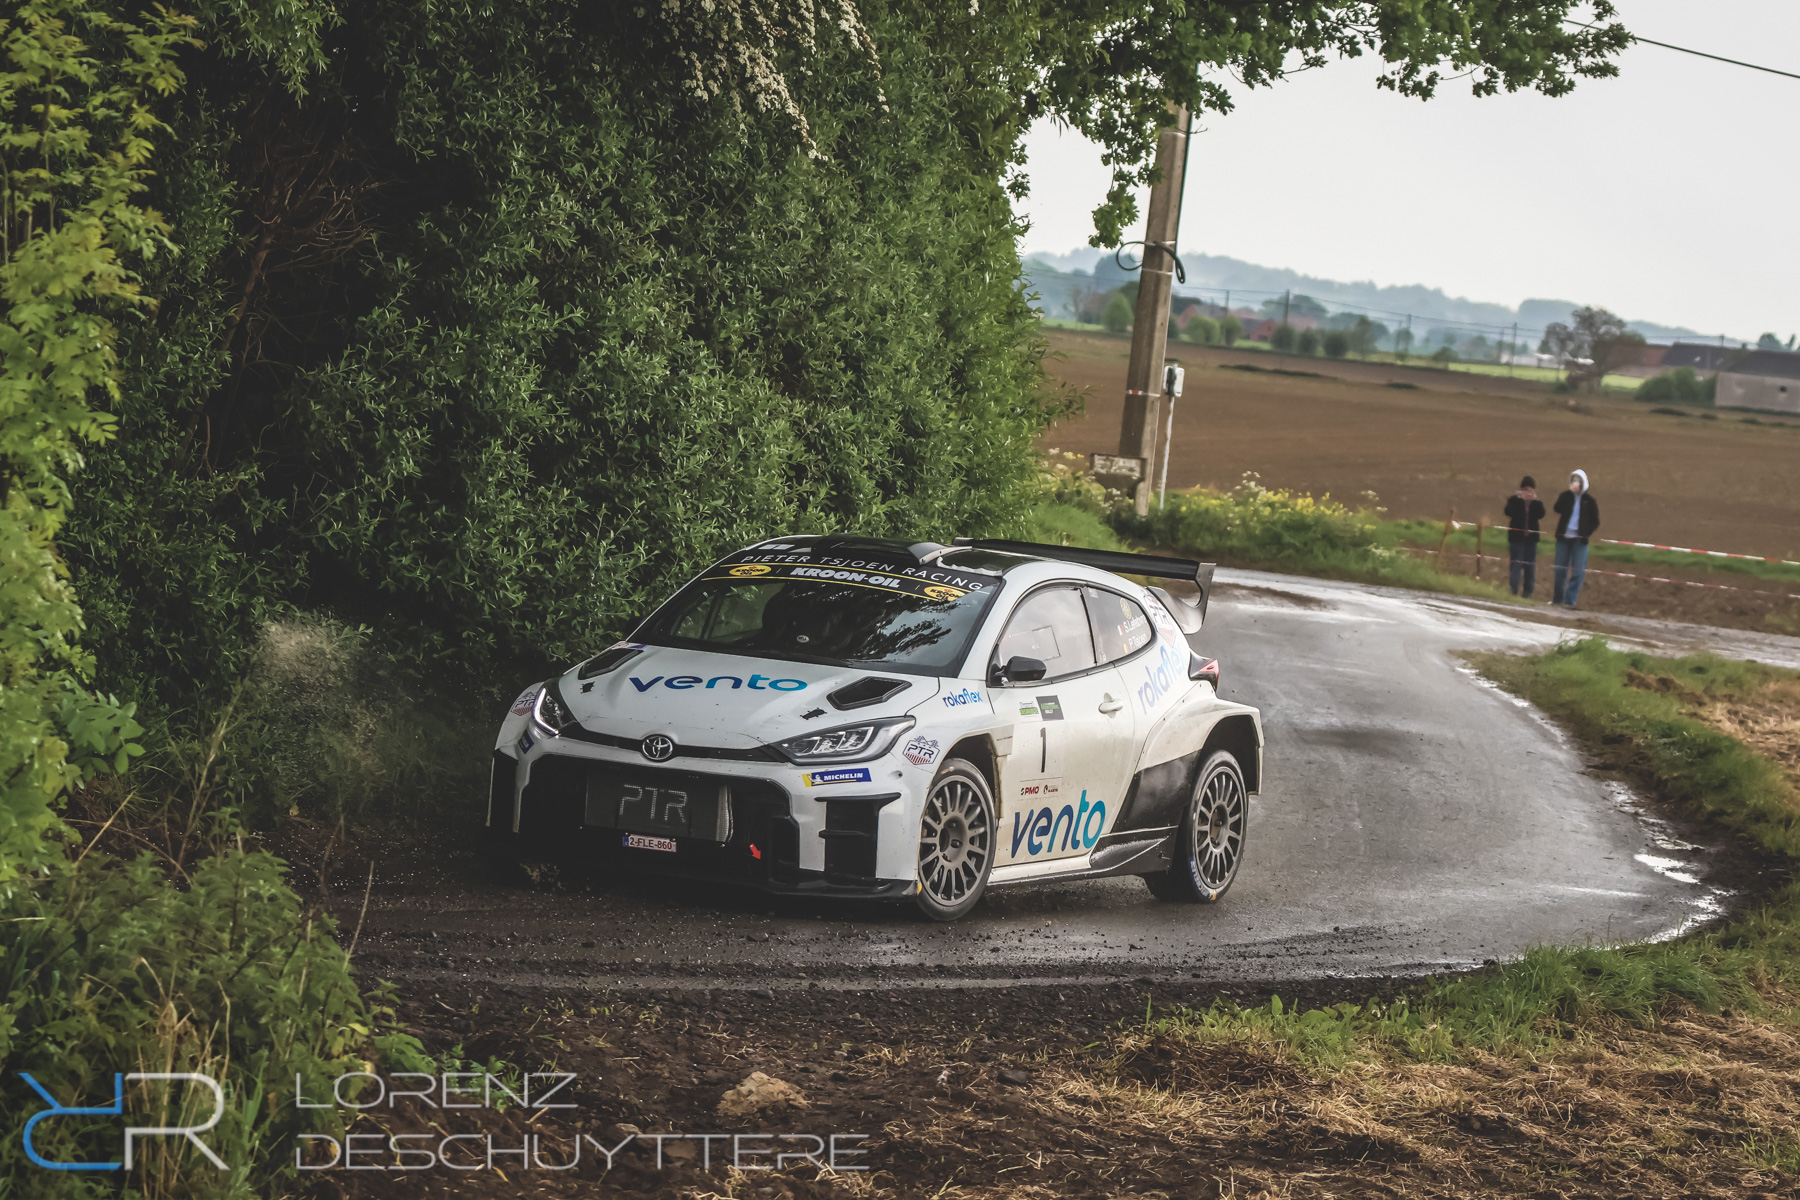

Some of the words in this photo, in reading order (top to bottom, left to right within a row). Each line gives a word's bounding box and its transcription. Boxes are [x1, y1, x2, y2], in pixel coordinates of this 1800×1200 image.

[740, 554, 811, 563] PIETER
[819, 556, 895, 572] TSJOEN
[901, 567, 983, 591] RACING
[790, 567, 901, 588] KROON-OIL
[629, 674, 808, 693] vento
[942, 687, 983, 709] rokaflex
[907, 743, 935, 758] PTR
[1040, 727, 1046, 773] 1
[823, 772, 864, 781] MICHELIN
[619, 784, 688, 823] PTR
[1011, 789, 1106, 858] vento
[629, 836, 672, 850] 2-FLE-860
